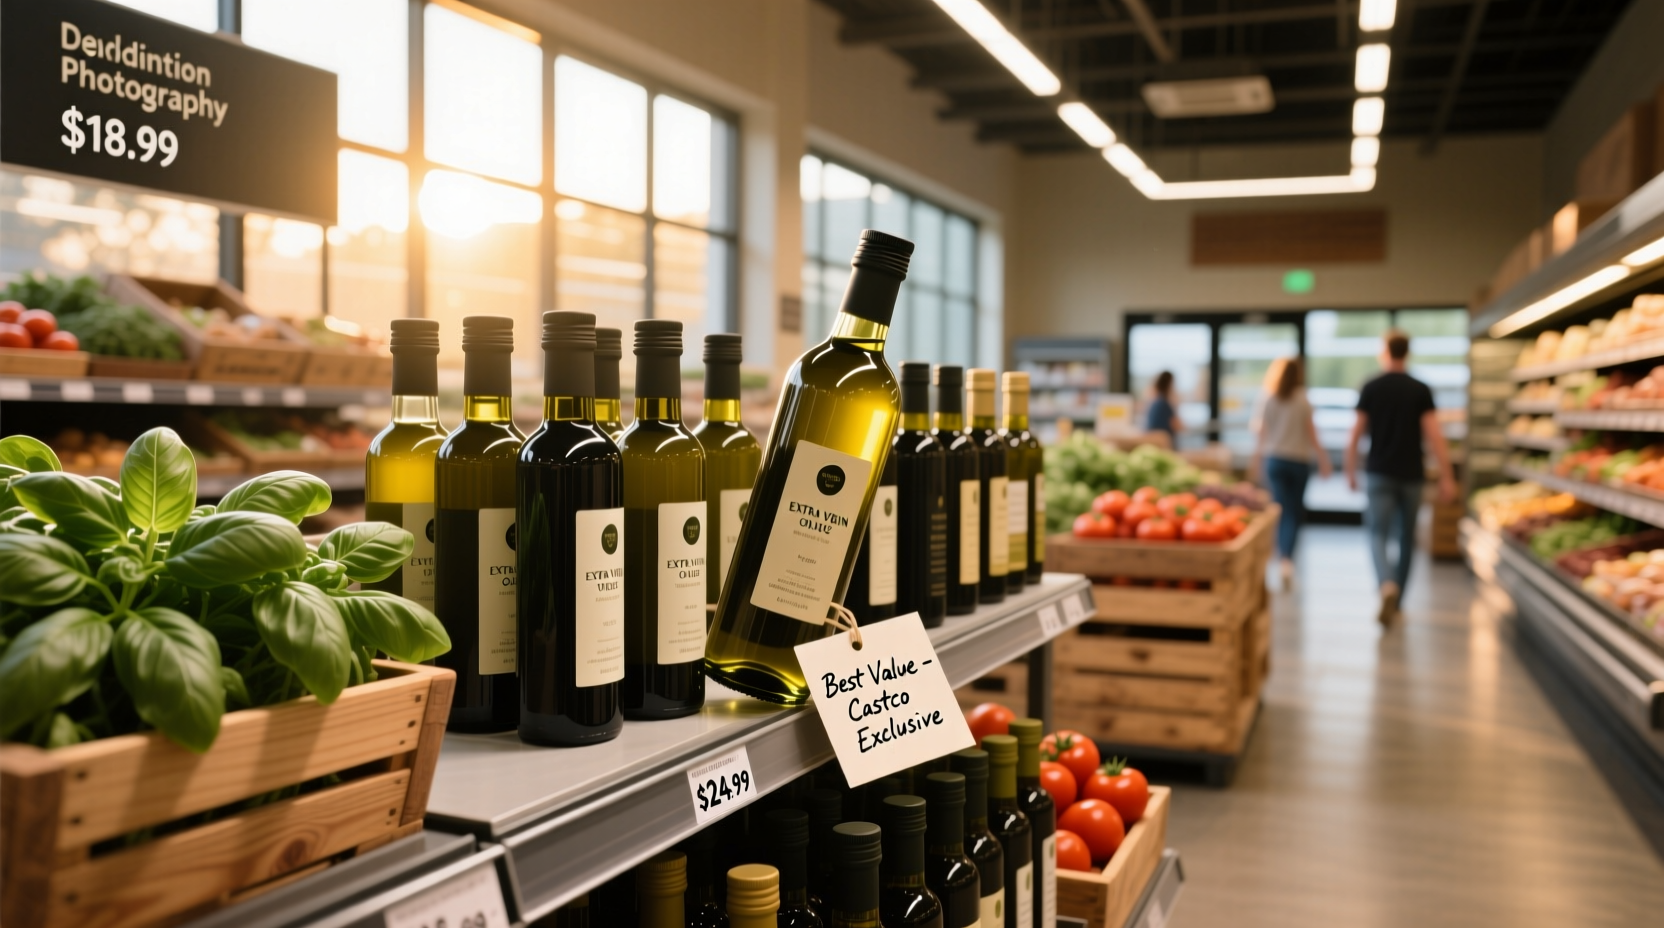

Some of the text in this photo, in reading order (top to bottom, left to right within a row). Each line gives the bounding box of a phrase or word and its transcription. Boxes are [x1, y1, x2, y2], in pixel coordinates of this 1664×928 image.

[60, 56, 229, 128] Photography
[60, 105, 179, 168] $18.99
[821, 667, 865, 699] Best
[867, 656, 918, 686] Value
[848, 689, 910, 722] Castco
[856, 710, 944, 753] Exclusive
[696, 770, 750, 812] $24.99
